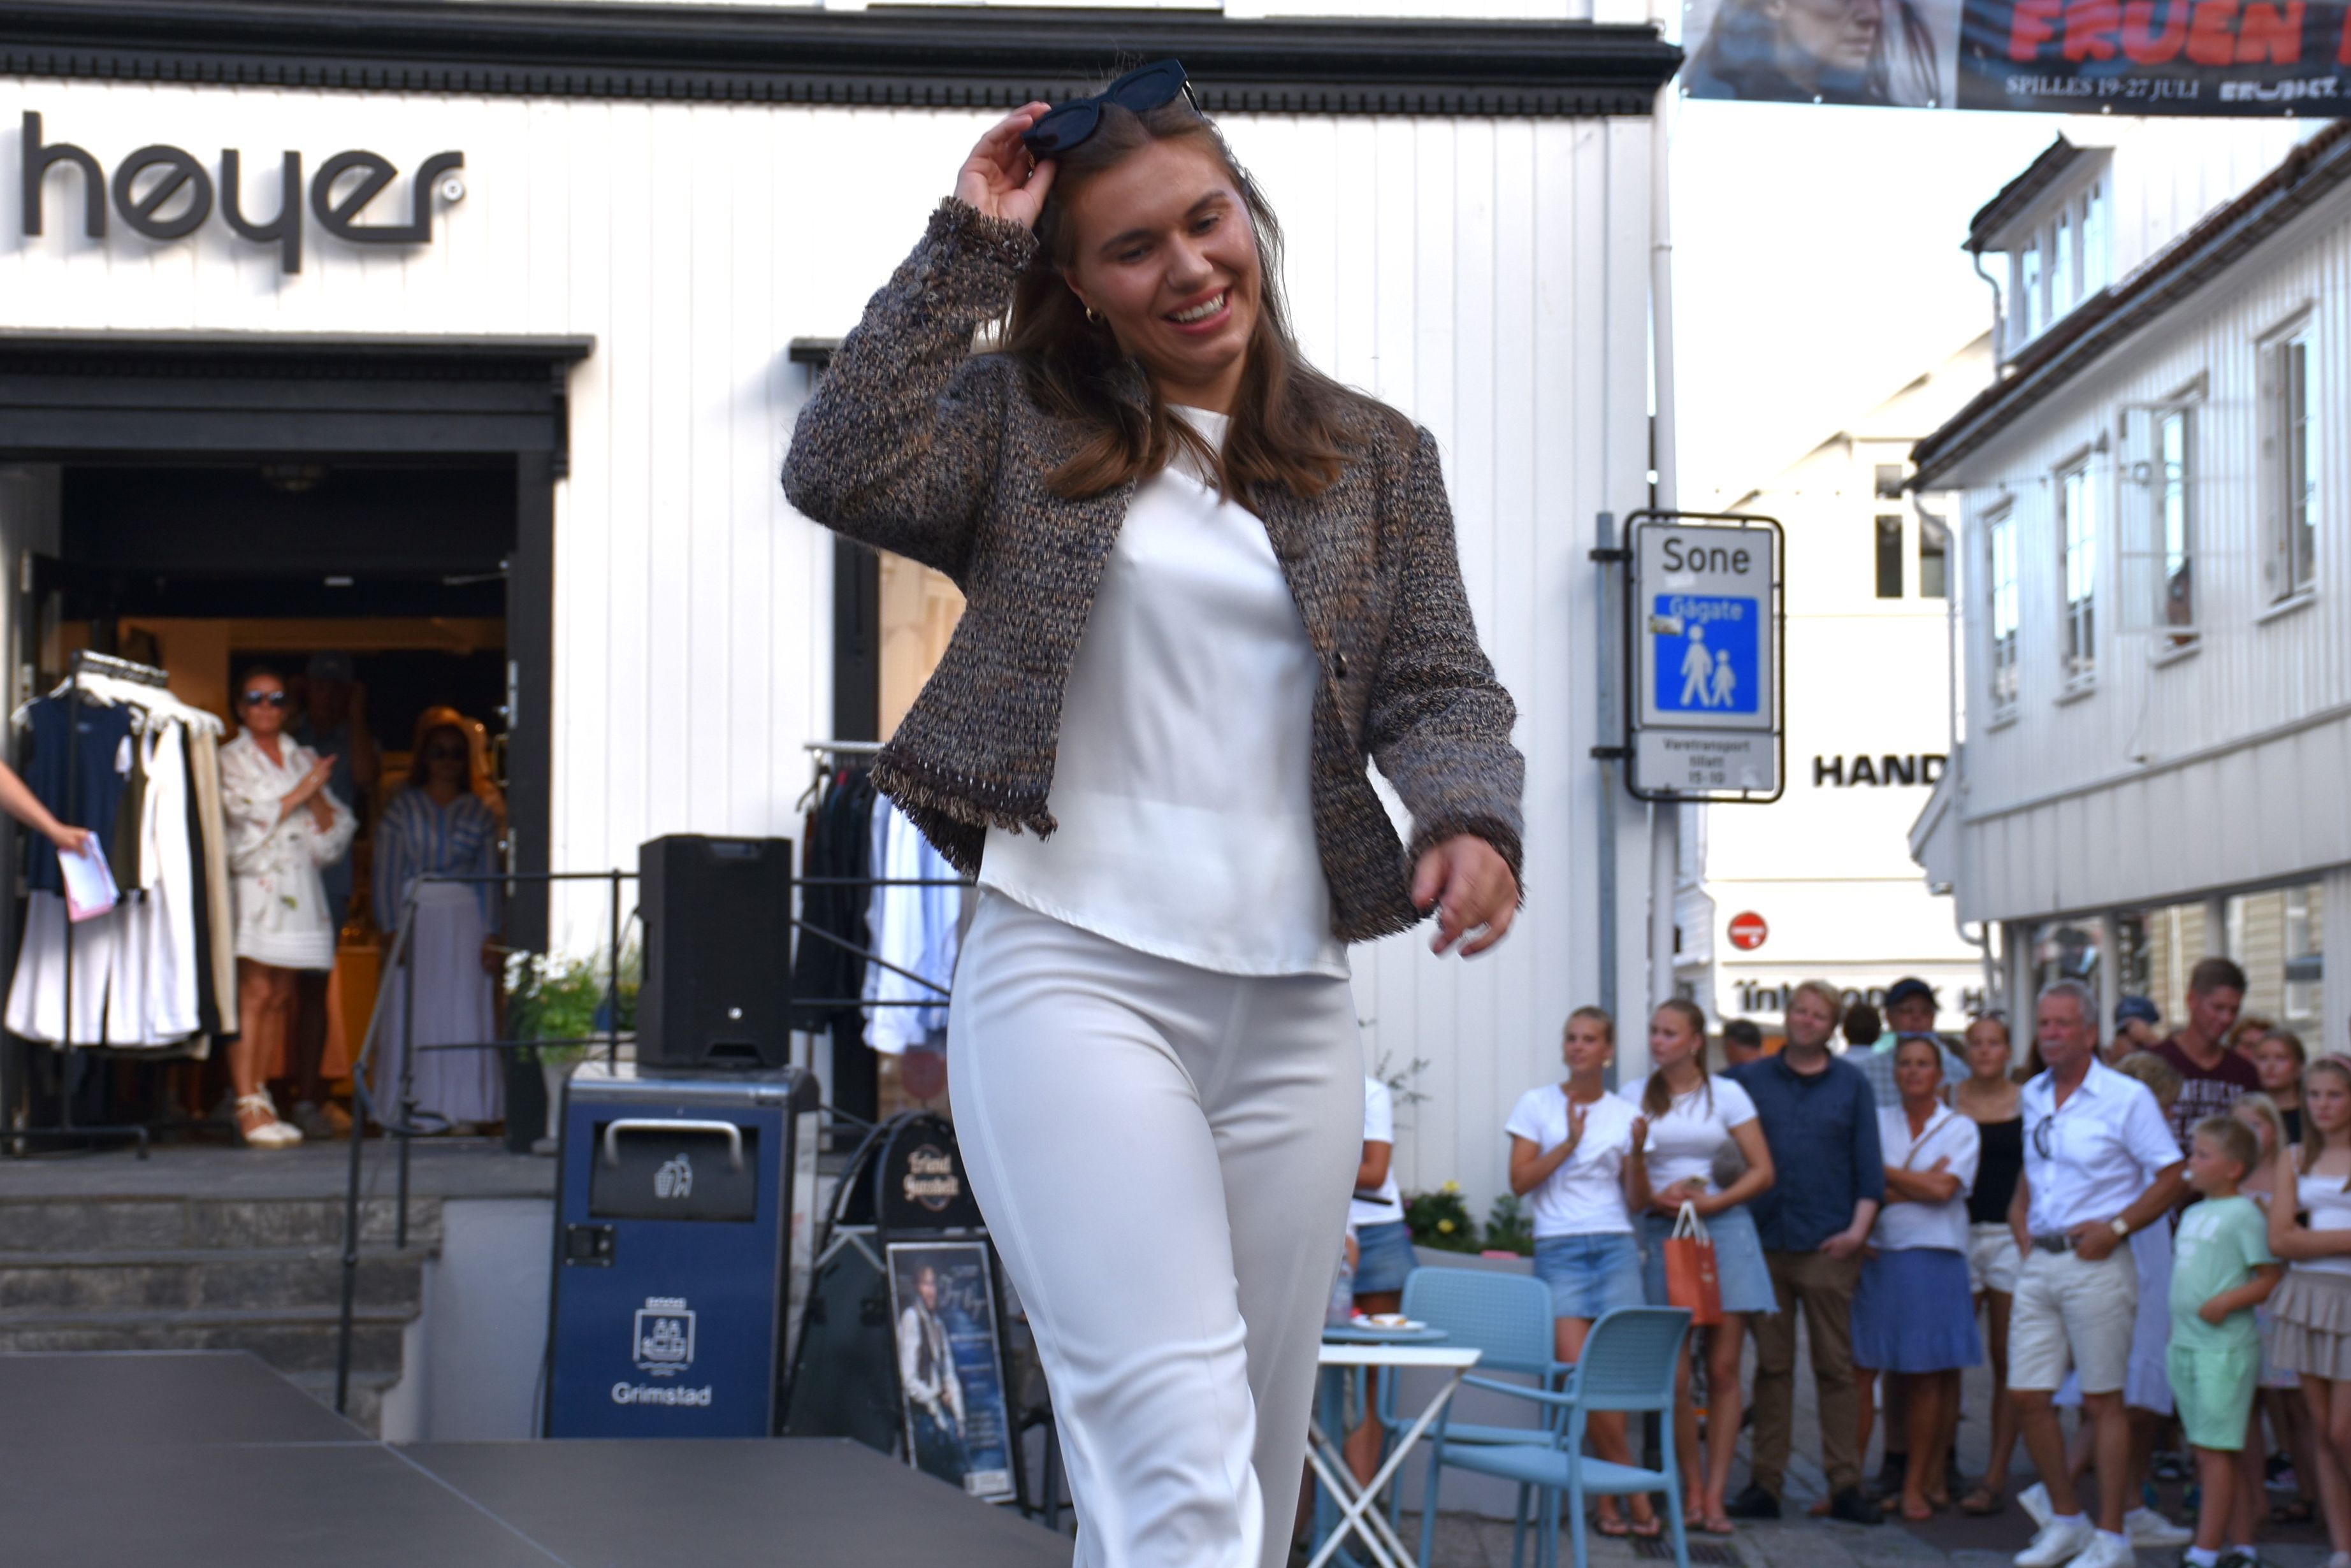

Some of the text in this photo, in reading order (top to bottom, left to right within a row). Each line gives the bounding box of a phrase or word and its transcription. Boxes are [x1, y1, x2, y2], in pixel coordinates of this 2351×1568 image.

[2009, 0, 2306, 64] FRUEN
[2005, 75, 2093, 97] SPILLES
[2148, 78, 2199, 102] JULI
[23, 110, 464, 275] høyer
[1662, 536, 1750, 575] Sone
[1670, 596, 1743, 624] Gågate
[1663, 737, 1751, 753] Varetransport
[612, 1381, 713, 1406] Grimstad
